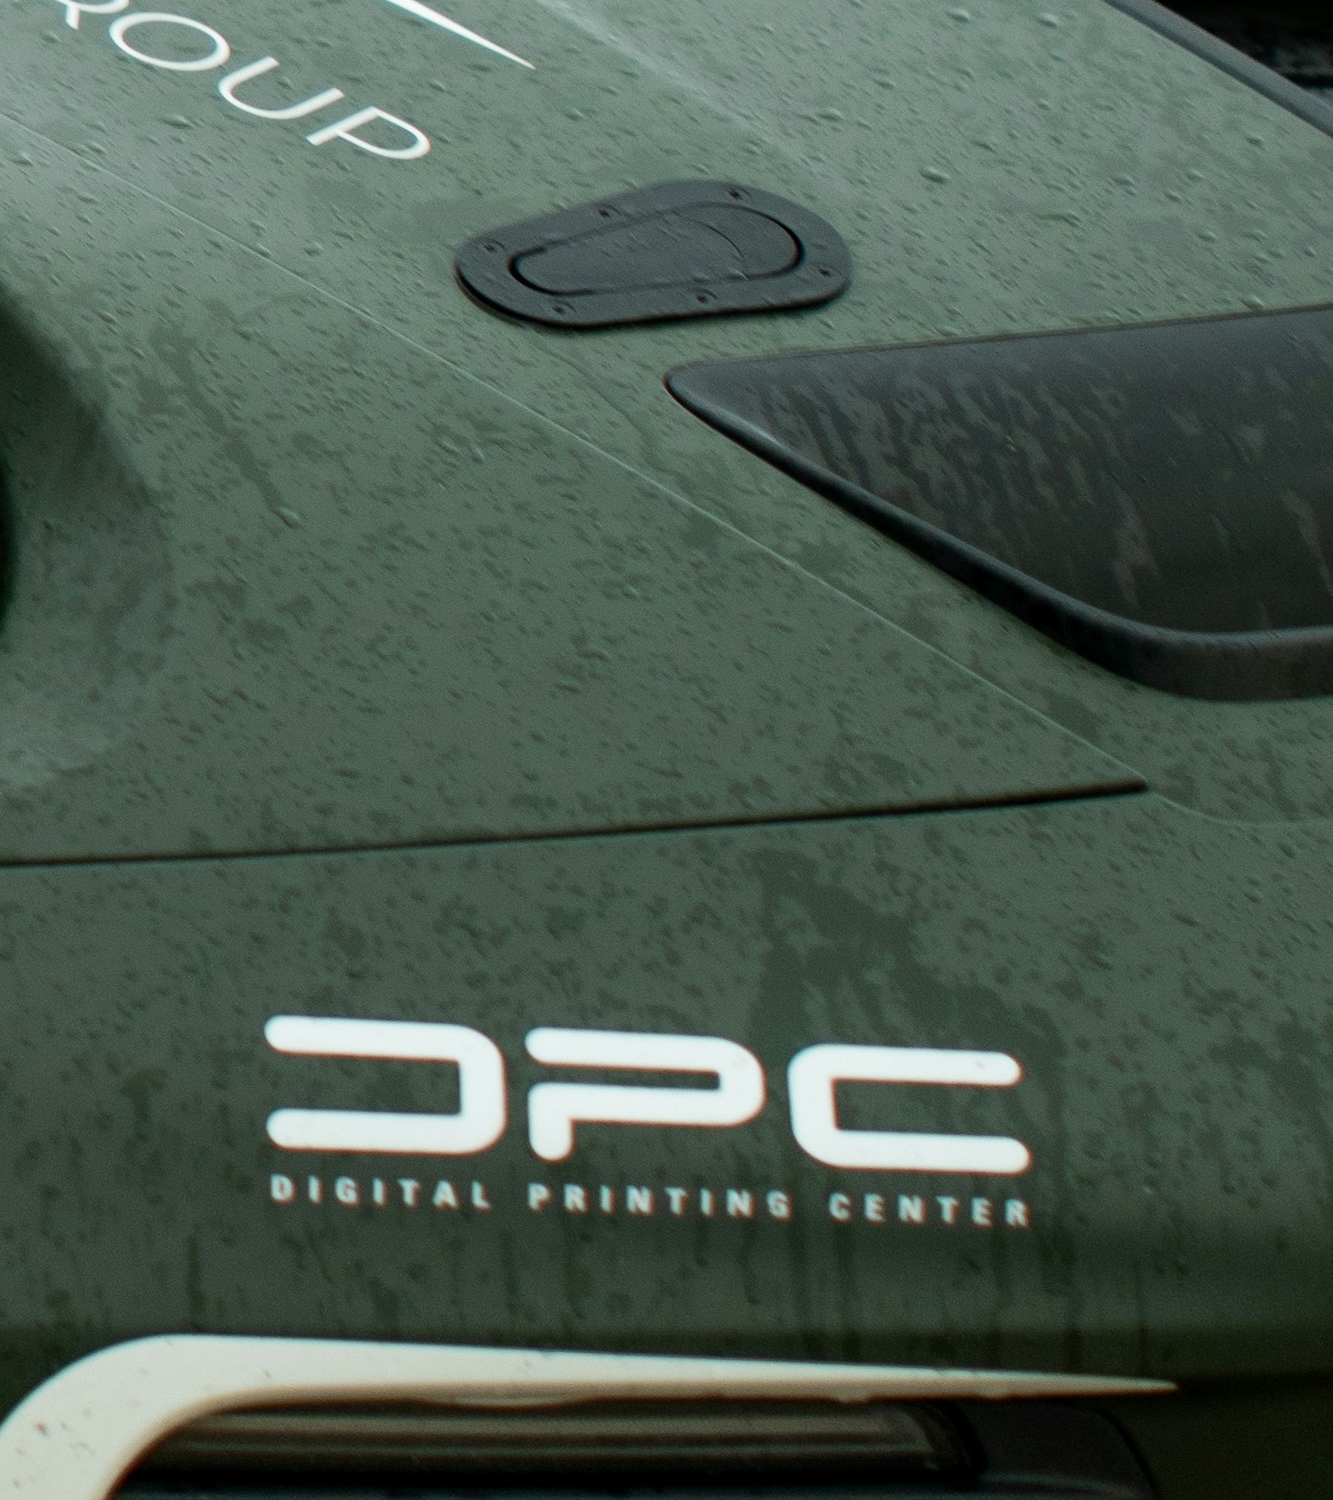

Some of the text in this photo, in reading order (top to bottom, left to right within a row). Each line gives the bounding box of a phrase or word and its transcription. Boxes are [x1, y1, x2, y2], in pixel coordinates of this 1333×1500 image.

[264, 1015, 1031, 1175] DPC
[270, 1174, 1031, 1227] DIGITAL PRINTING CENTER
